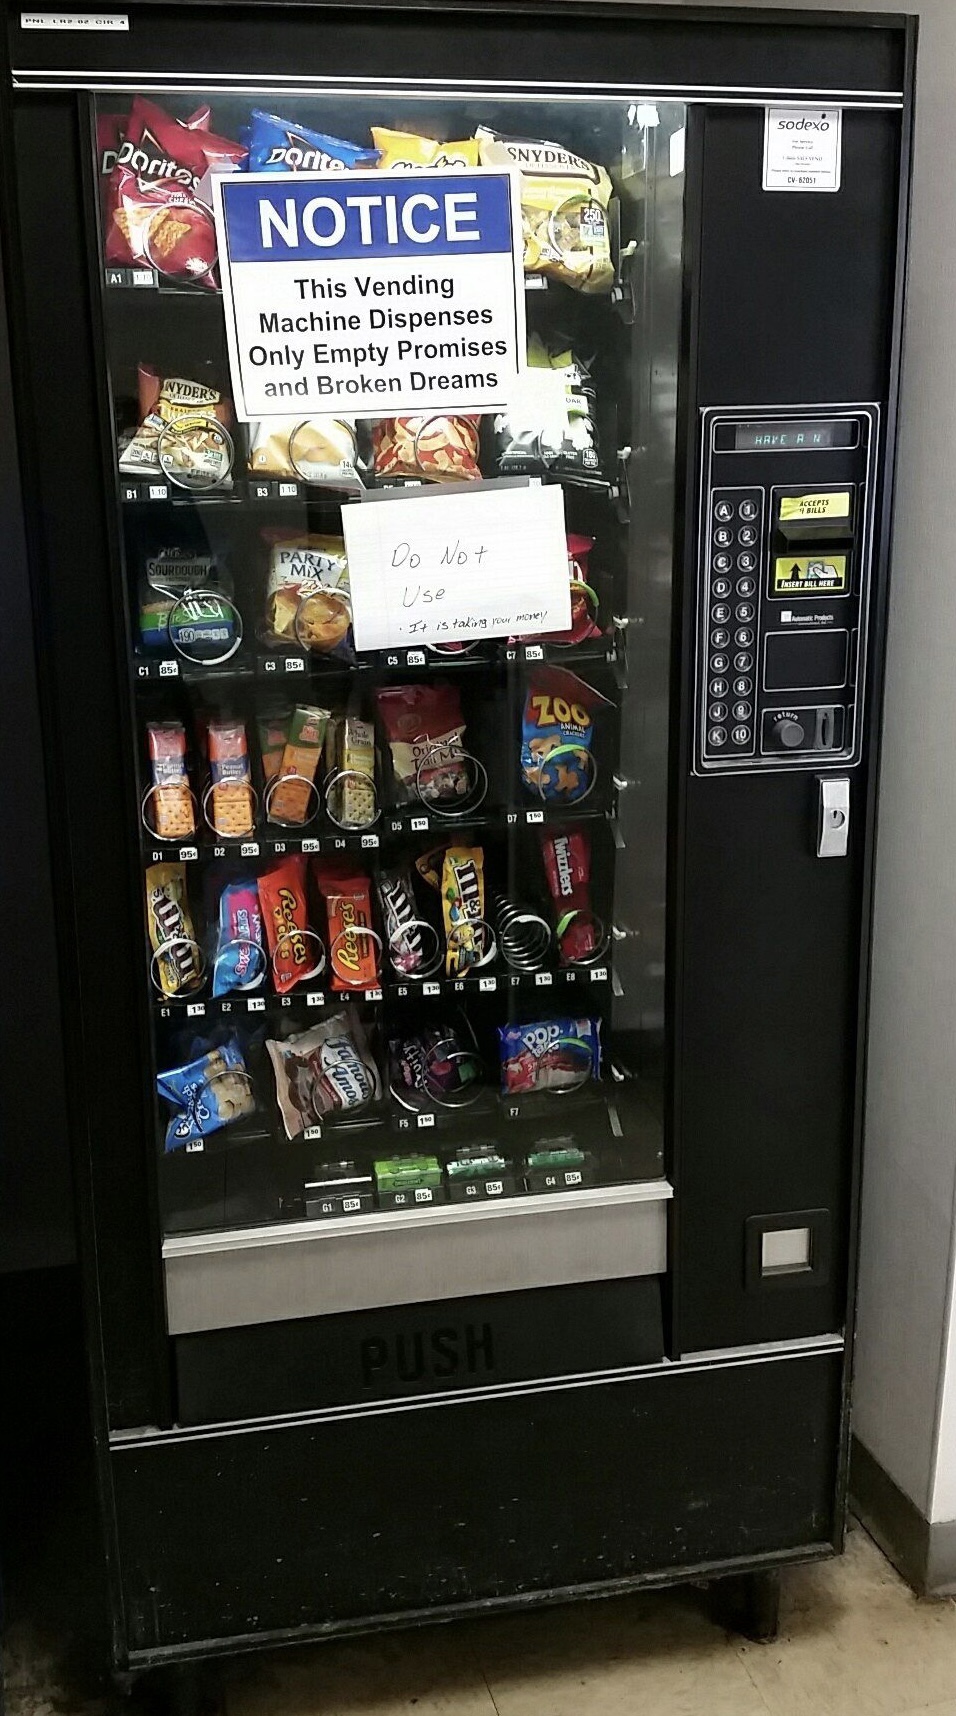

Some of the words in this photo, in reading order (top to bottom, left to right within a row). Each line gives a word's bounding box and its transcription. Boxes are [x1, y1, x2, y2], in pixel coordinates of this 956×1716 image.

[777, 118, 829, 131] sodexo
[266, 147, 349, 171] Dorito
[117, 142, 201, 194] Doritos
[259, 192, 480, 248] NOTICE
[111, 273, 122, 283] A1
[294, 277, 347, 300] This
[355, 275, 454, 298] Vending
[259, 311, 361, 333] Machine
[369, 308, 493, 332] Dispenses
[249, 345, 305, 370] Only
[313, 342, 389, 367] Empty
[397, 337, 507, 360] Promises
[264, 377, 308, 397] and
[317, 374, 402, 395] Broken
[410, 371, 498, 391] Dreams
[754, 434, 786, 445] HAVE
[796, 434, 806, 443] A
[813, 433, 821, 443] N
[126, 490, 137, 499] B1
[257, 488, 268, 497] B3
[800, 499, 829, 507] ACCEPTS
[720, 505, 728, 515] A
[719, 531, 727, 541] B
[743, 530, 751, 541] 2
[391, 542, 421, 568] Do
[440, 539, 488, 565] Not
[280, 551, 336, 571] PARTY
[719, 557, 727, 567] C
[743, 556, 750, 567] 3
[149, 562, 207, 576] SOURDOUGH
[718, 582, 726, 592] D
[741, 581, 749, 591] 4
[781, 580, 803, 588] INSERT
[403, 585, 445, 608] Use
[717, 608, 725, 617] E
[741, 607, 748, 617] 5
[408, 620, 429, 634] It
[436, 621, 449, 631] is
[453, 617, 487, 629] taking
[492, 617, 511, 628] your
[515, 610, 548, 624] money
[180, 631, 194, 641] 190
[716, 633, 723, 642] F
[741, 632, 747, 642] 6
[506, 650, 516, 660] C7
[387, 655, 398, 666] C5
[715, 658, 724, 668] G
[739, 657, 746, 666] 7
[265, 662, 276, 671] C3
[138, 667, 149, 677] C1
[714, 682, 723, 692] H
[738, 681, 745, 691] 8
[532, 695, 590, 727] ZOO
[714, 707, 721, 716] J
[737, 706, 744, 715] 9
[773, 711, 799, 722] return
[560, 722, 586, 733] ANIMAL
[713, 731, 720, 740] K
[735, 730, 746, 740] 10
[411, 755, 437, 771] Tail
[507, 814, 517, 823] D7
[391, 821, 402, 830] D5
[275, 843, 285, 852] D3
[335, 839, 346, 848] D4
[153, 851, 163, 861] D1
[214, 847, 225, 856] D2
[554, 836, 573, 895] Twizzlers
[511, 977, 520, 986] E7
[566, 972, 576, 981] E8
[398, 987, 408, 996] E5
[455, 982, 464, 991] E6
[282, 997, 291, 1006] E3
[340, 992, 350, 1001] E4
[222, 1003, 231, 1011] E2
[161, 1008, 170, 1017] E1
[531, 1042, 560, 1058] tas
[324, 1057, 359, 1105] Amos
[510, 1108, 519, 1116] F7
[400, 1119, 409, 1127] F5
[545, 1176, 556, 1186] G4
[466, 1186, 477, 1194] G3
[395, 1194, 406, 1204] G2
[322, 1203, 332, 1212] G1
[361, 1322, 494, 1390] PUSH
